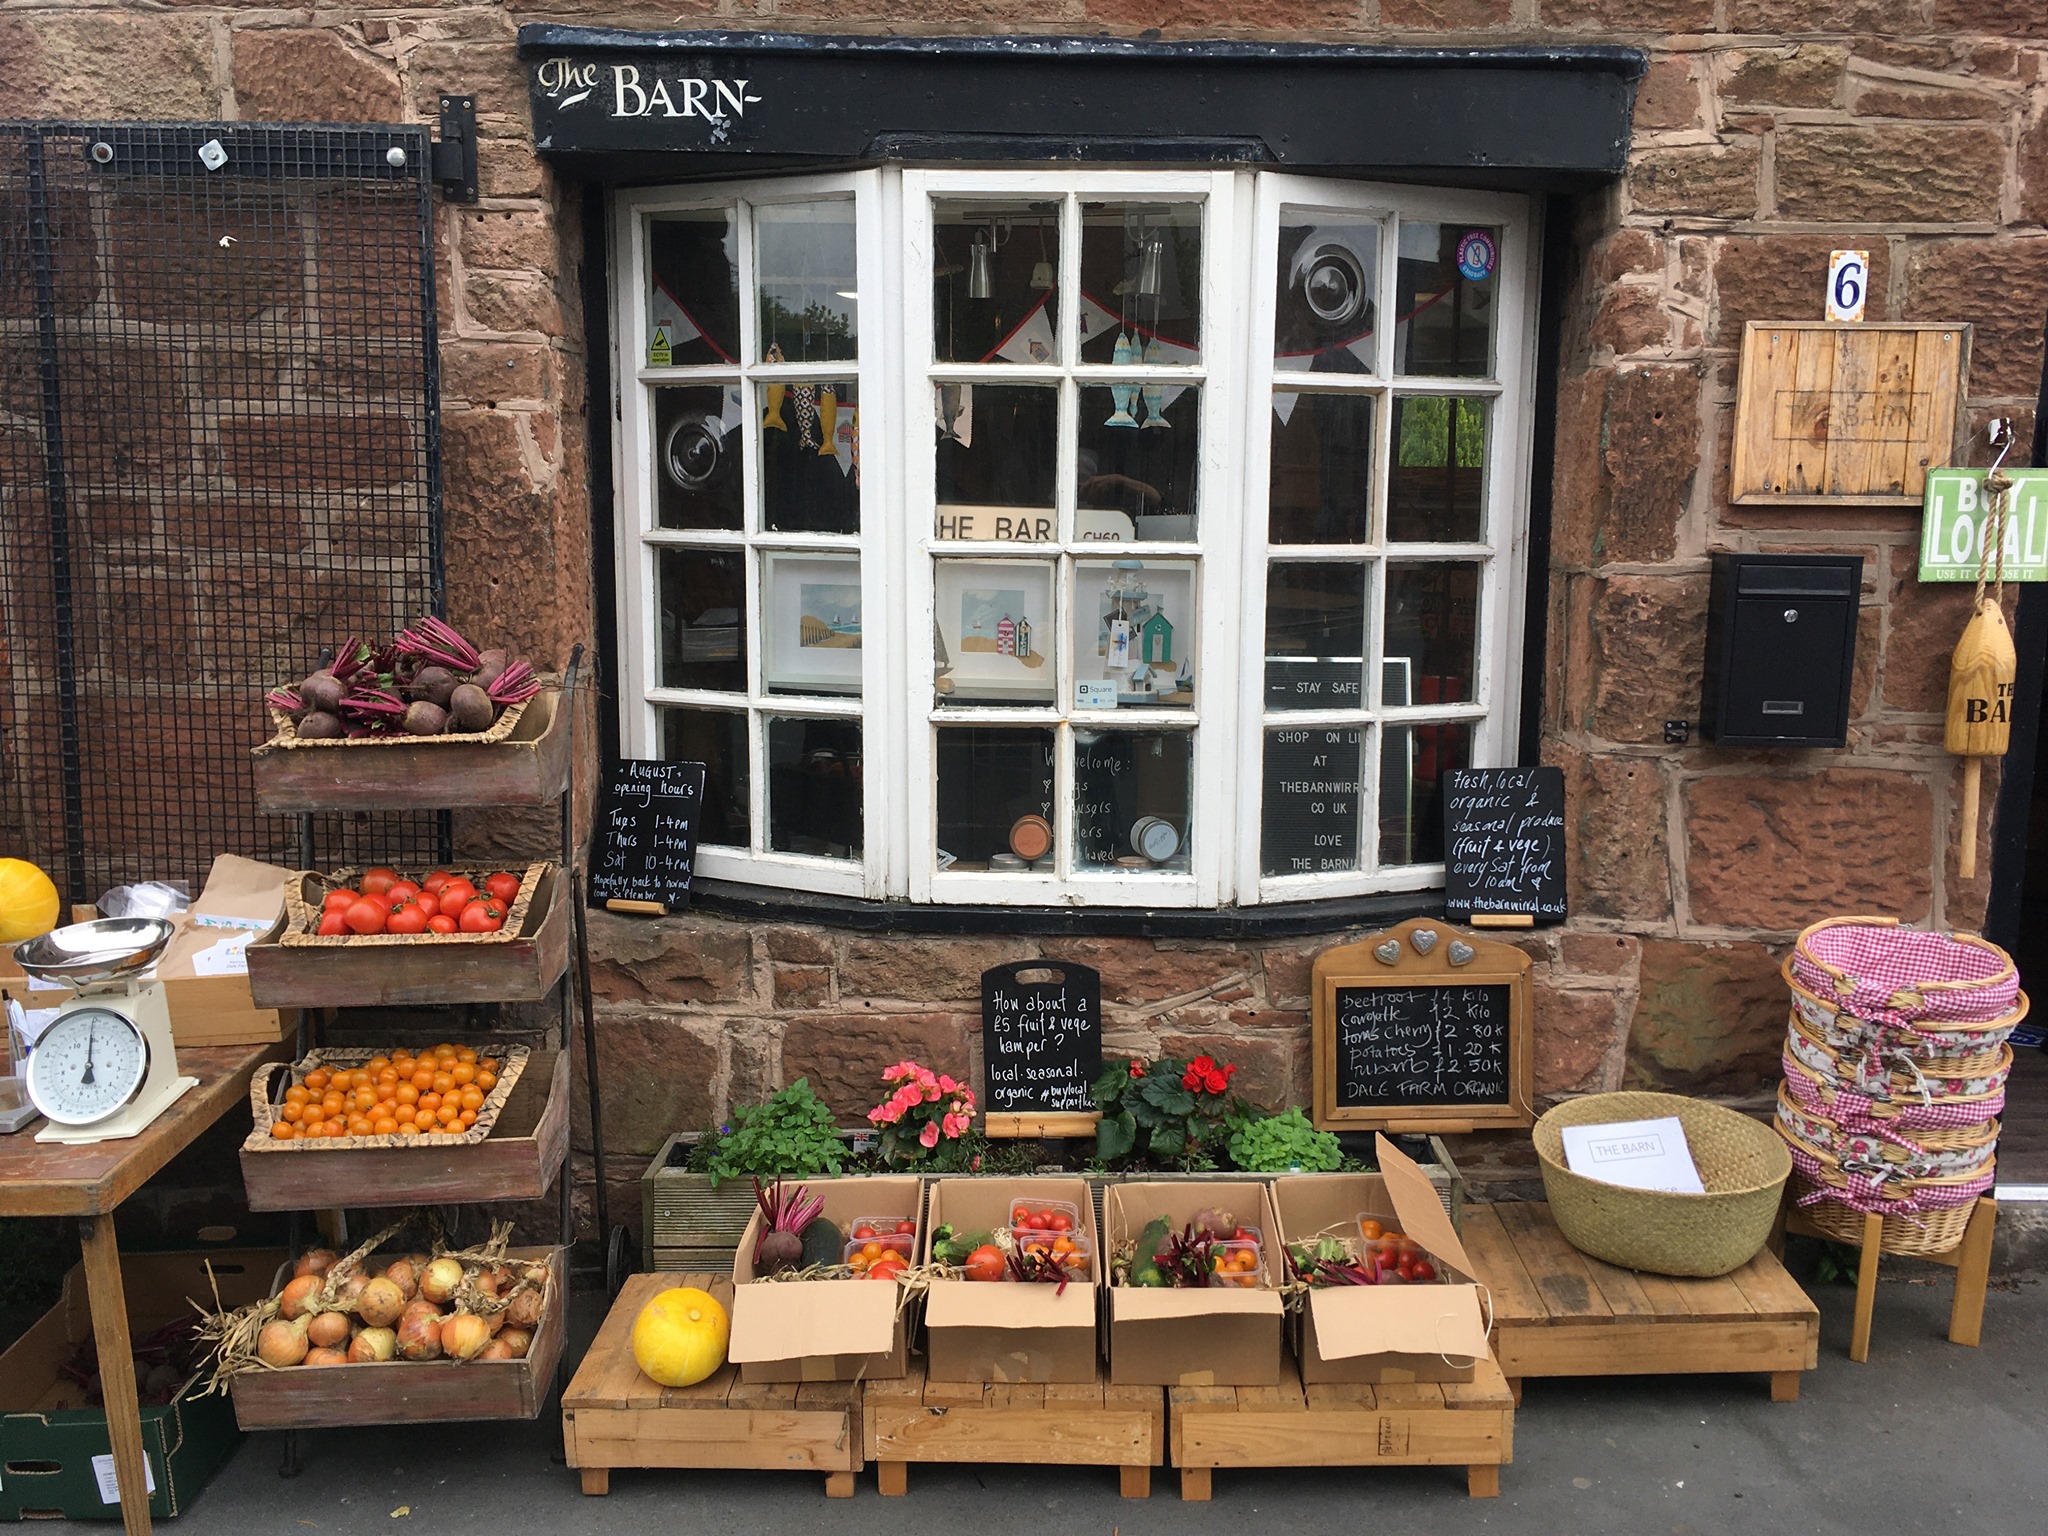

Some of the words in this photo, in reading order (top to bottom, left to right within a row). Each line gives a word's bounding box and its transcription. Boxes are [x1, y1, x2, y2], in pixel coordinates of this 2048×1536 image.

[538, 56, 598, 98] The
[1834, 262, 1862, 309] 6
[1847, 404, 1917, 428] BARN
[934, 516, 974, 540] HE
[995, 516, 1051, 540] BAR
[1936, 569, 1956, 579] USE
[1960, 569, 1972, 579] IT
[1995, 569, 2018, 579] OSE
[2022, 569, 2034, 579] IT
[1090, 686, 1112, 694] Square
[1296, 682, 1322, 694] STAY
[1332, 682, 1359, 694] SAFE
[1278, 732, 1310, 742] SHOP
[1326, 732, 1340, 743] ON
[1312, 755, 1328, 766] AT
[630, 761, 677, 779] AUGUST
[614, 781, 652, 808] opening
[660, 780, 694, 796] hours
[1311, 802, 1324, 814] CO
[1333, 802, 1346, 814] UK
[1450, 794, 1510, 820] organic
[1525, 792, 1540, 807] &
[609, 808, 636, 830] Tues
[1452, 812, 1516, 834] seasonal
[1518, 810, 1564, 838] produce
[606, 831, 638, 848] Thurs
[1314, 834, 1342, 846] LOVE
[1493, 840, 1505, 852] &
[604, 851, 627, 870] Sat
[1290, 858, 1312, 870] THE
[1453, 860, 1488, 888] every
[1490, 855, 1516, 880] Sat
[1519, 857, 1552, 883] from
[654, 875, 661, 888] to
[1485, 875, 1522, 892] 10am
[993, 990, 1019, 1013] How
[1026, 987, 1066, 1012] about
[1077, 998, 1087, 1012] a
[1017, 1012, 1045, 1038] fruit
[1048, 1016, 1056, 1030] &
[995, 1086, 1034, 1108] organic
[1596, 1144, 1620, 1157] THE
[1622, 1140, 1656, 1154] BARN
